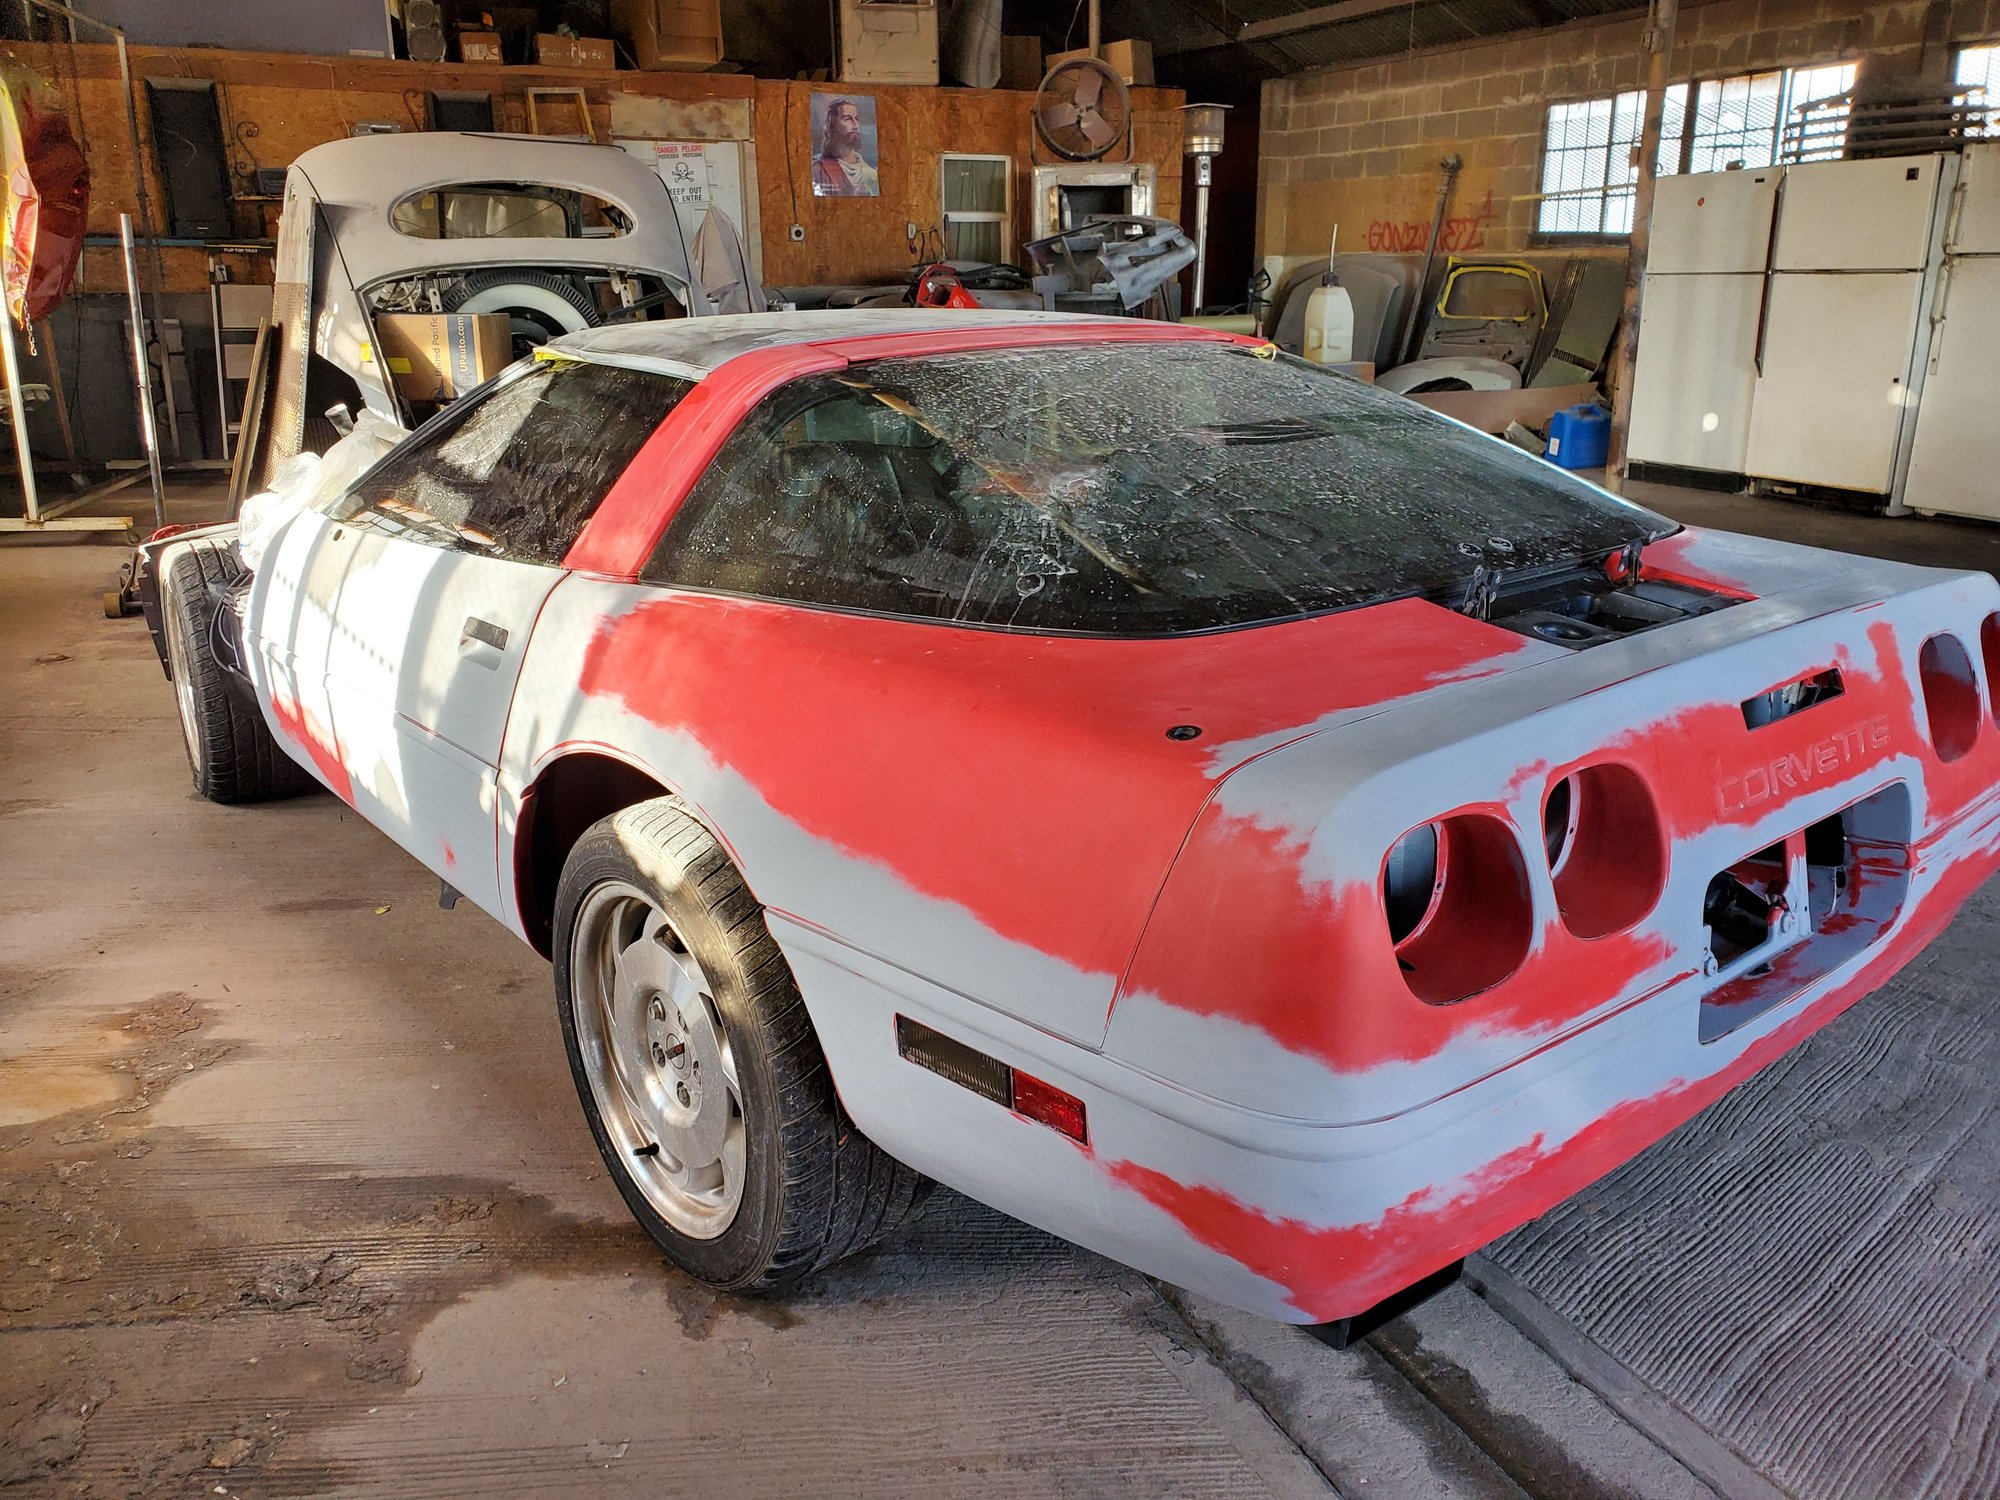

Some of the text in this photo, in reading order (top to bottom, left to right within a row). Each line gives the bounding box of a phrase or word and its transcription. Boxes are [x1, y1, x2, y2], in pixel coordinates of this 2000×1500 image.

[657, 145, 678, 153] DANGER
[669, 187, 702, 196] KEEP OUT
[430, 316, 442, 377] United Pacific
[458, 316, 468, 372] UPauto.com
[1717, 713, 1891, 818] CORVETTE
